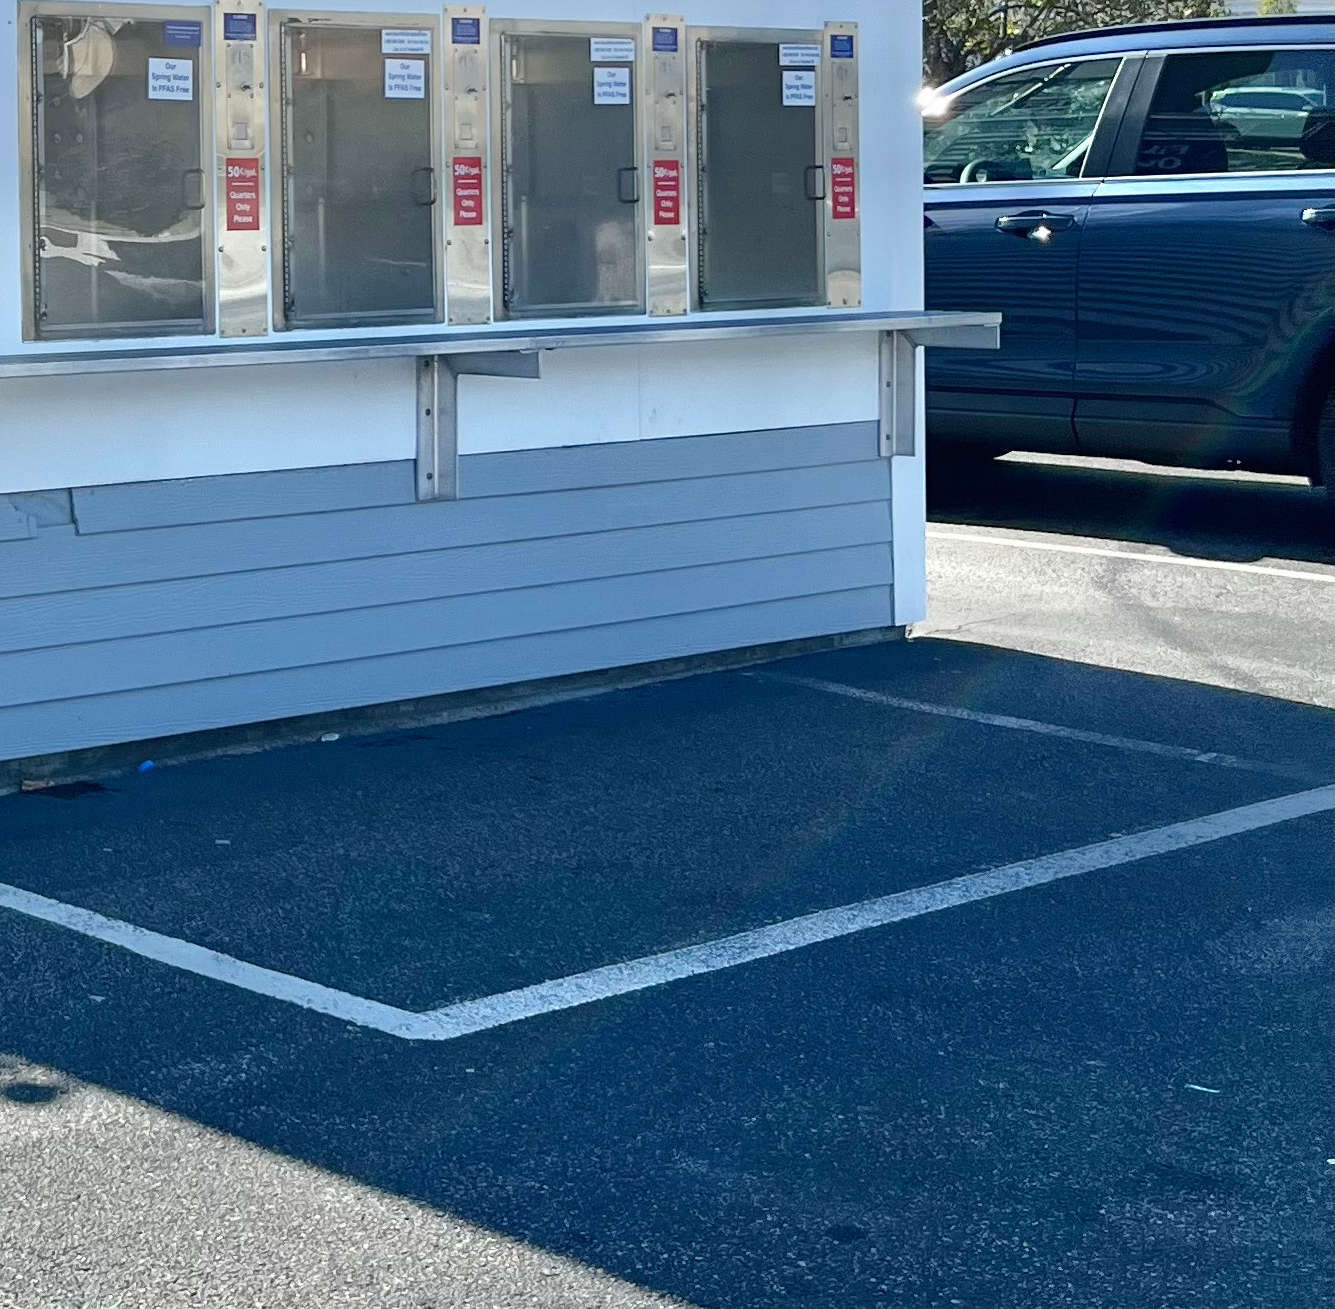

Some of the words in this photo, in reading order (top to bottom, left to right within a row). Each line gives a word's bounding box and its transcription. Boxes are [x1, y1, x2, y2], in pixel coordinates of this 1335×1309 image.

[165, 62, 177, 70] Our
[151, 73, 172, 82] Spring
[175, 85, 190, 93] Free
[235, 203, 251, 211] Only
